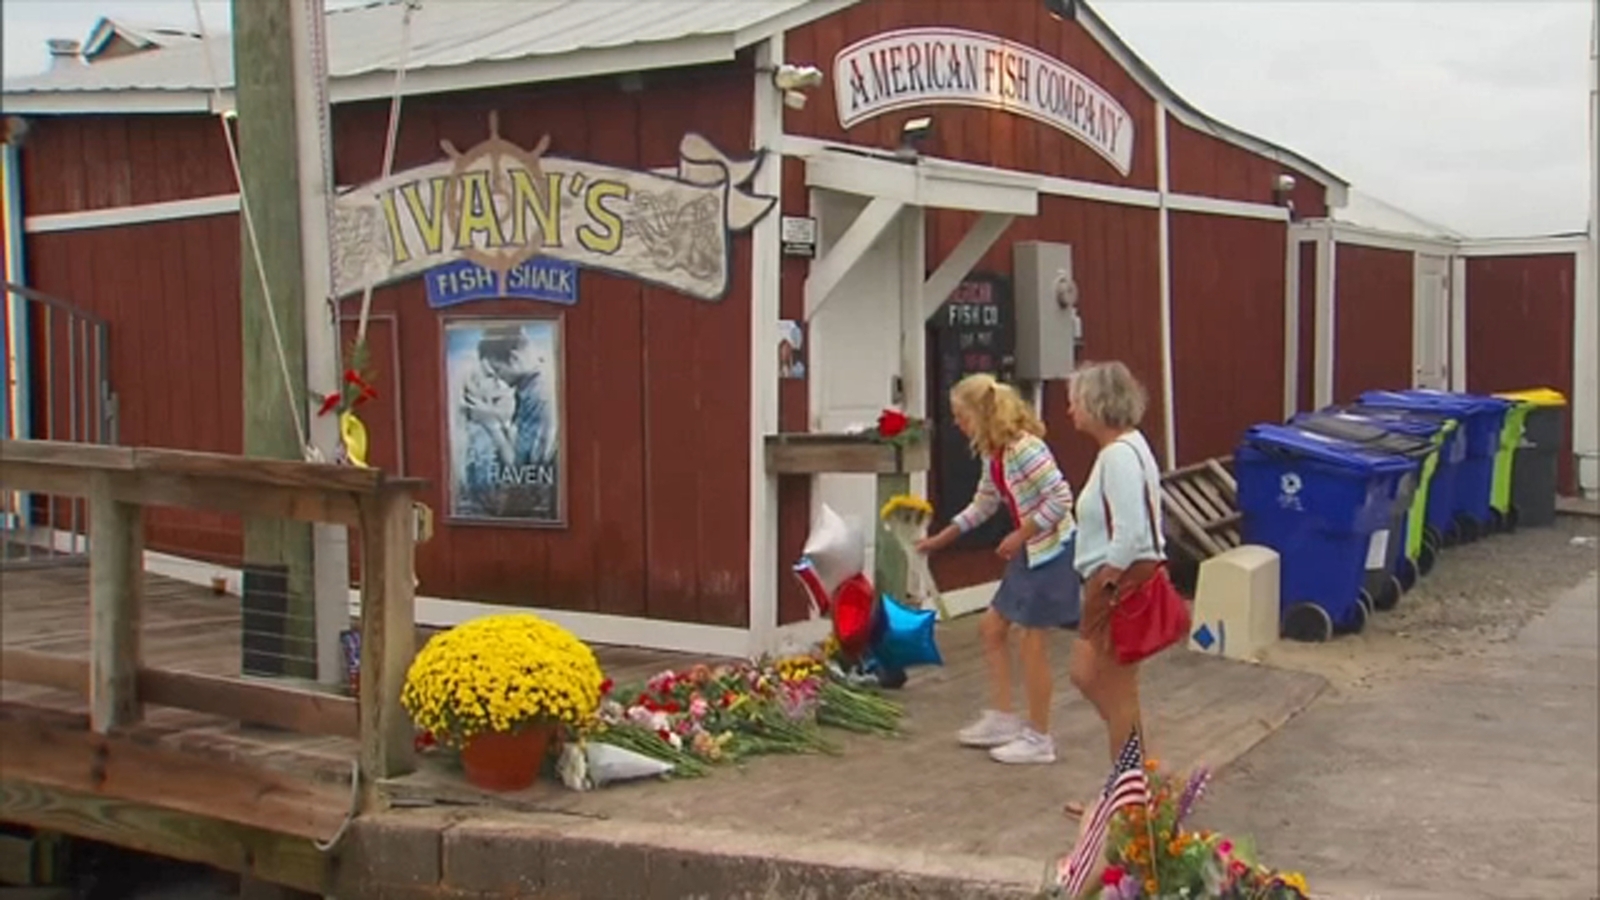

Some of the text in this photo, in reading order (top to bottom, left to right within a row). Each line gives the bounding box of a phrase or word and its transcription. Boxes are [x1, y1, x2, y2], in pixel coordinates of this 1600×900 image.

[849, 41, 1123, 153] AMERICAN FISH COMPANY
[374, 168, 630, 263] IVAN'S
[436, 264, 572, 296] FISH SHACK
